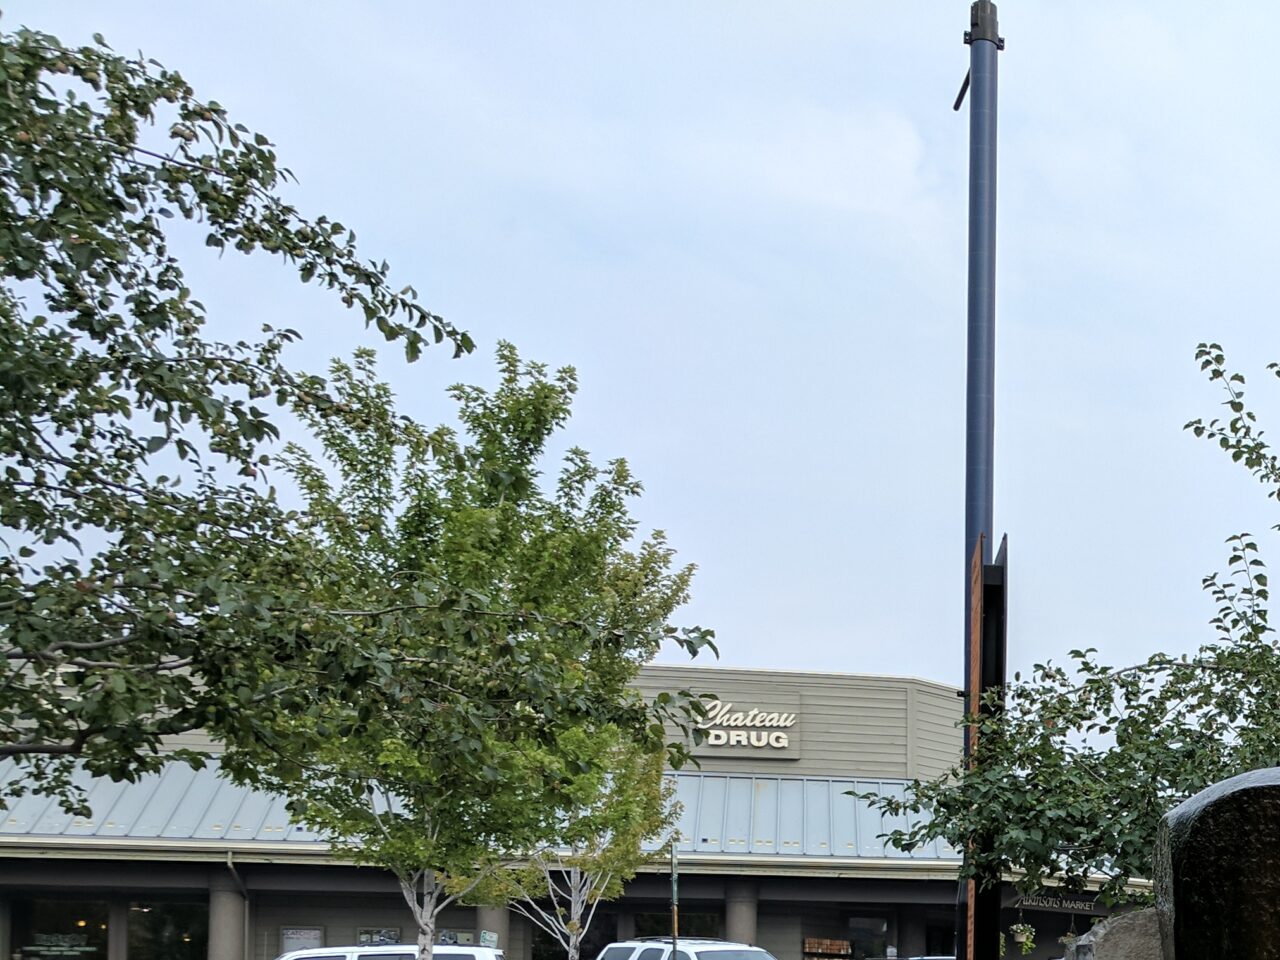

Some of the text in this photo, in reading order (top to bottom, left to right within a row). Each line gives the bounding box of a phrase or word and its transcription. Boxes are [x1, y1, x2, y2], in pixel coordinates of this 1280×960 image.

[698, 700, 796, 728] Chateau
[708, 729, 788, 748] DRUG
[1062, 900, 1095, 911] MARKET
